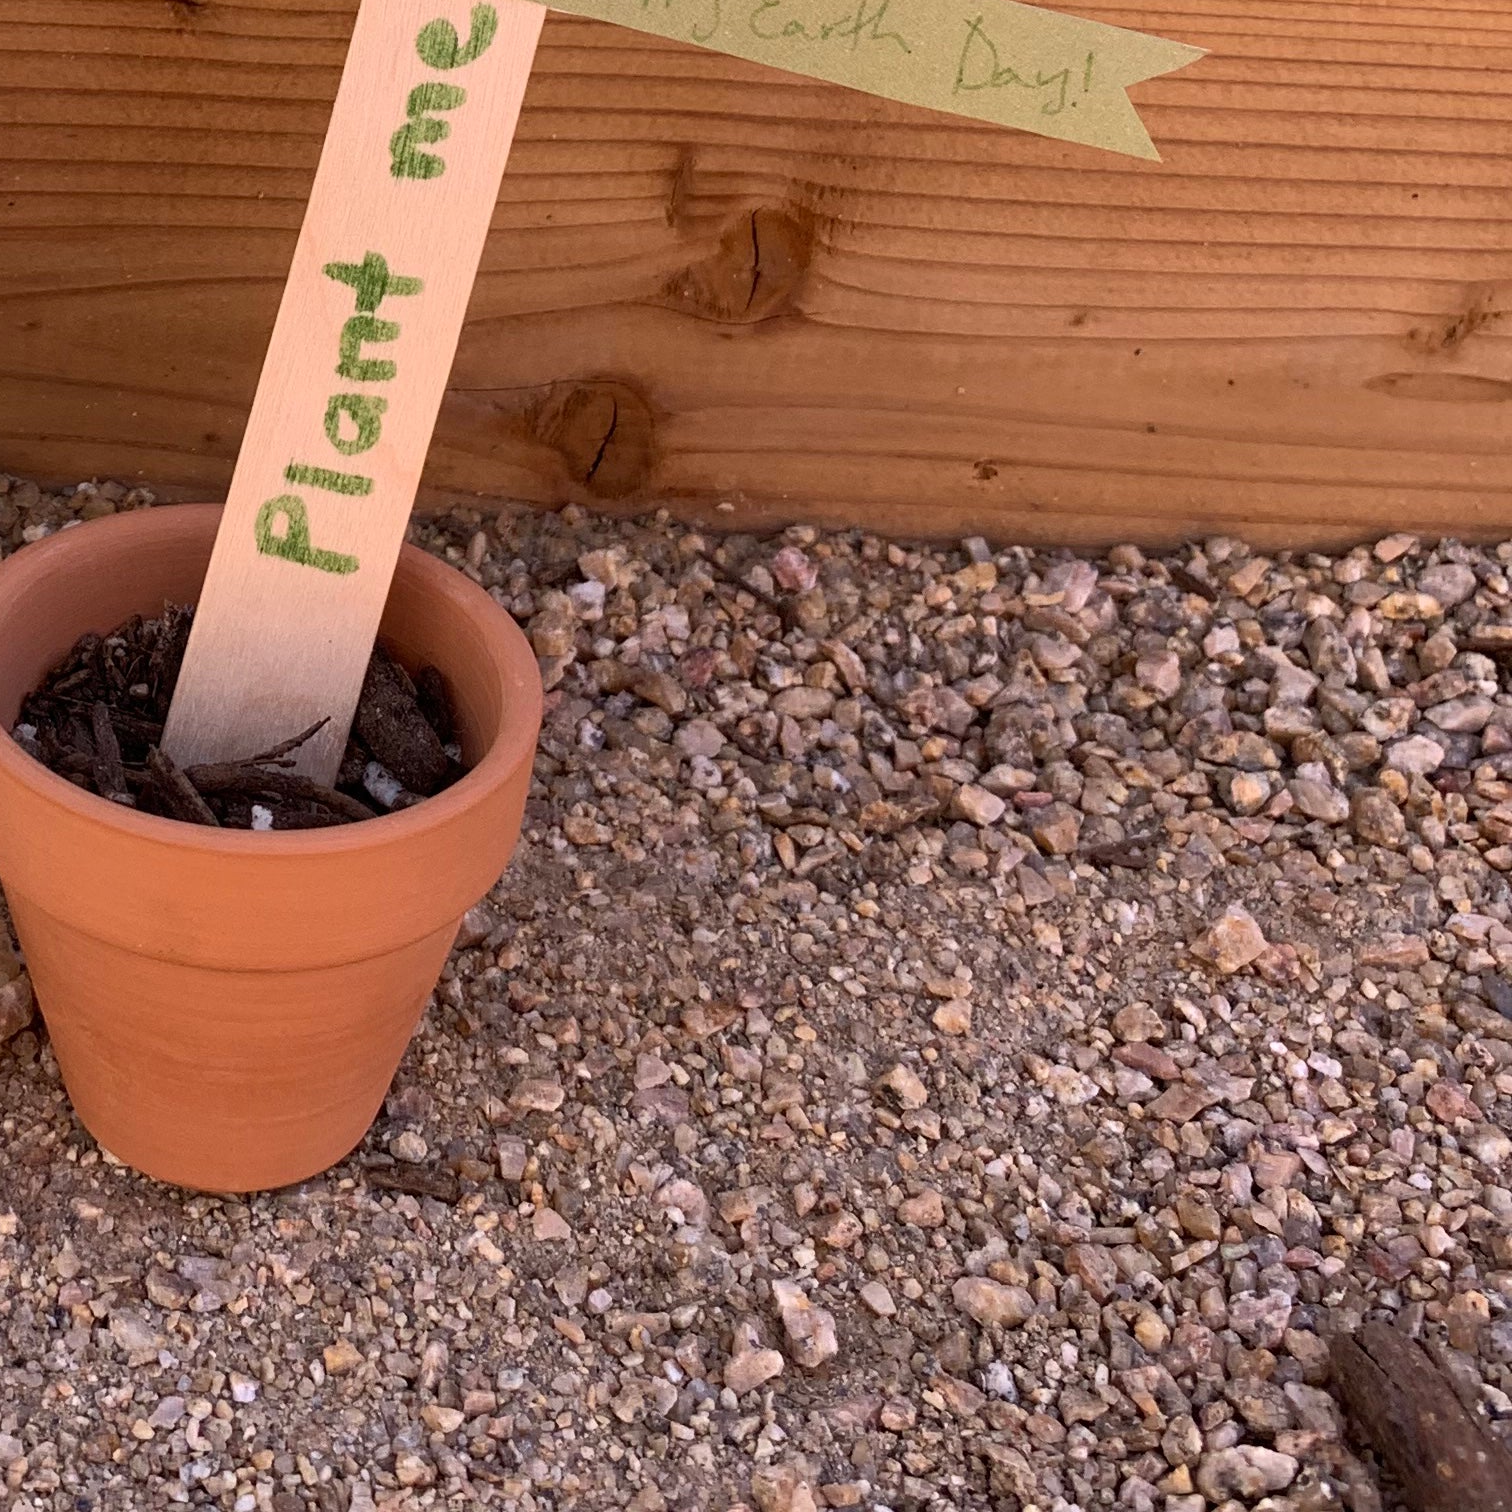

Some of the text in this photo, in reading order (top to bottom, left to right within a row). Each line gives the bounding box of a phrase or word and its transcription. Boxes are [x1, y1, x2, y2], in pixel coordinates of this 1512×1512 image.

[952, 16, 1098, 116] Day!
[254, 1, 499, 576] Plant me
